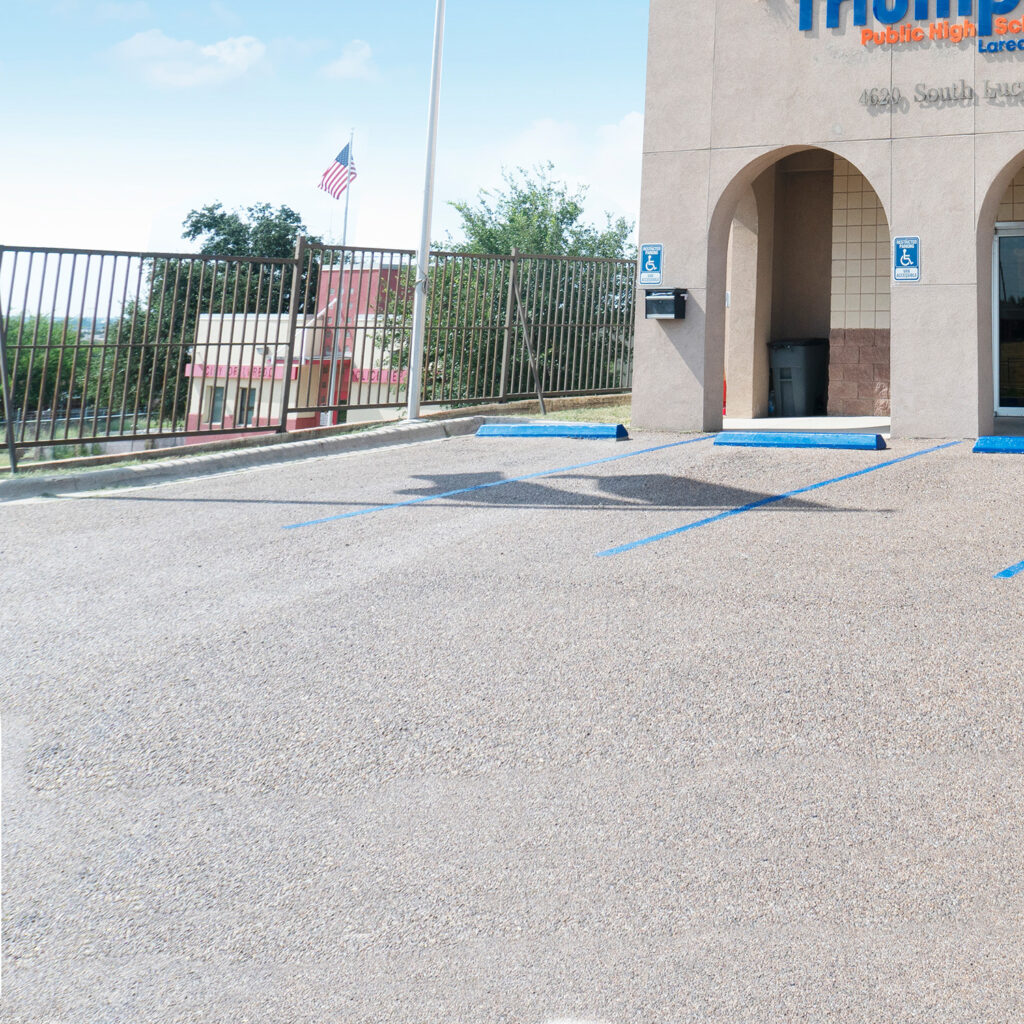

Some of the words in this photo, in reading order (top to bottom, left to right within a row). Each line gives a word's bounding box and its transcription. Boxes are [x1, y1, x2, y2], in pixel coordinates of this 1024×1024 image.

[861, 25, 925, 46] Public
[929, 19, 977, 43] High
[858, 87, 901, 106] 4620
[913, 79, 974, 103] South
[205, 366, 223, 376] CIY
